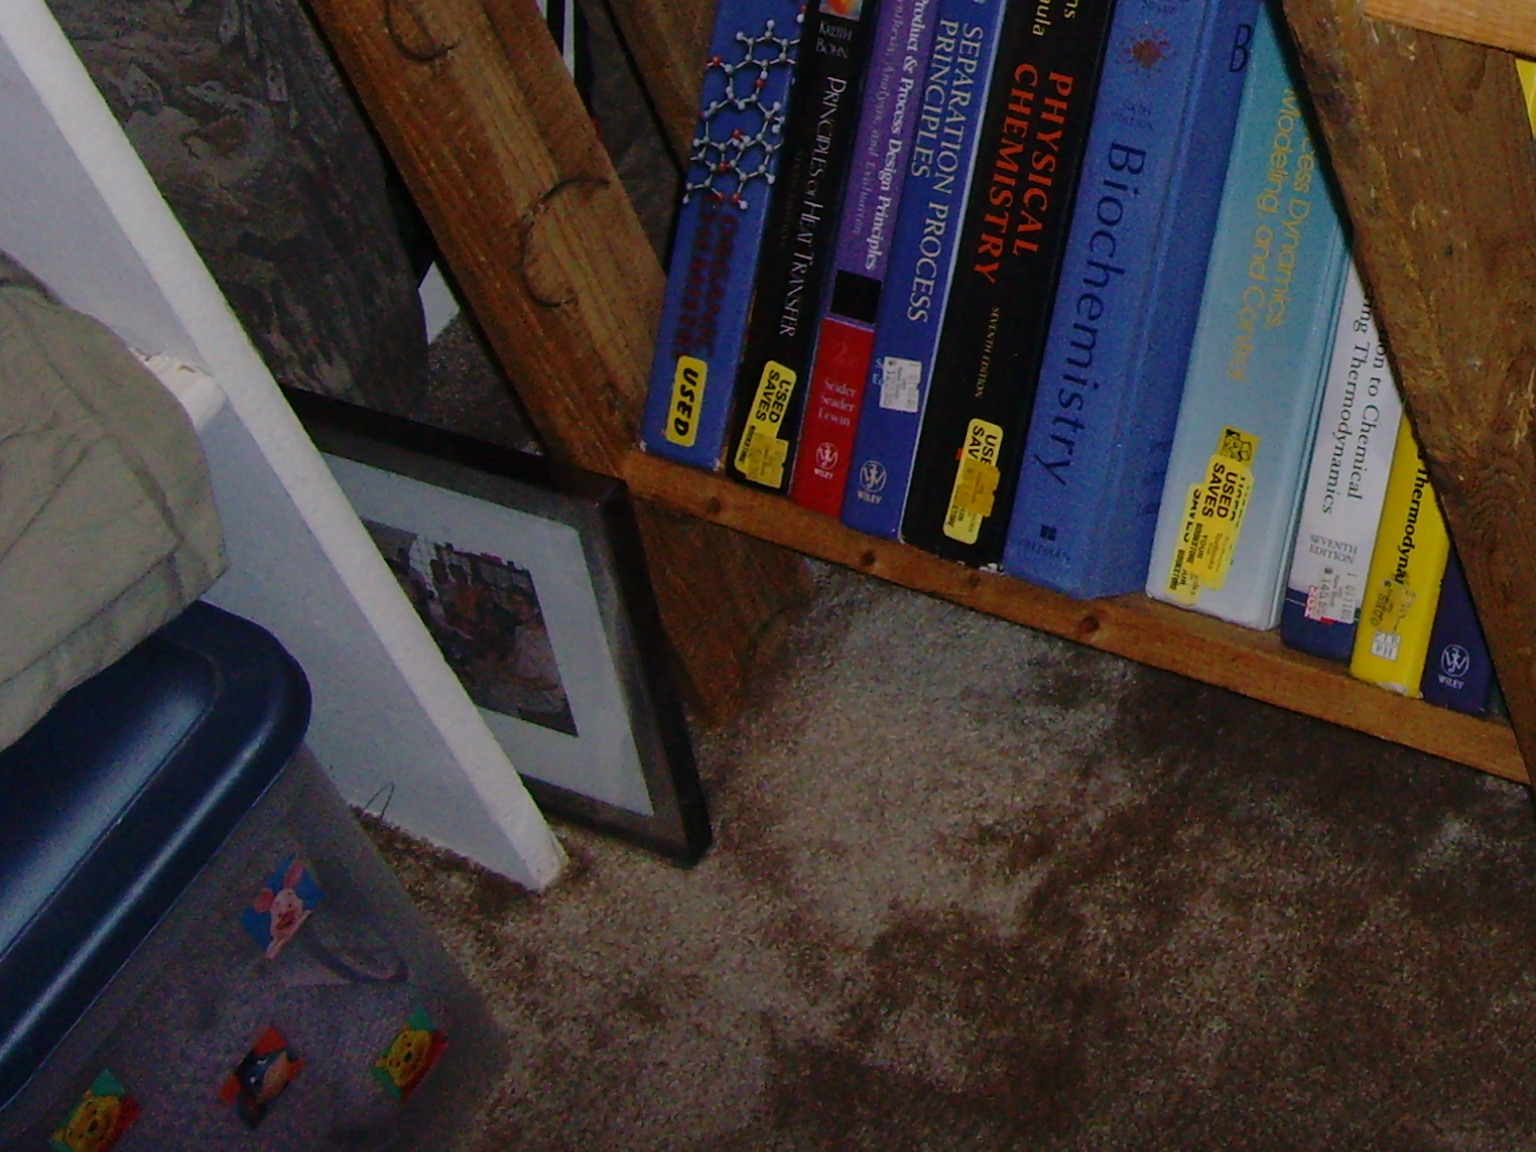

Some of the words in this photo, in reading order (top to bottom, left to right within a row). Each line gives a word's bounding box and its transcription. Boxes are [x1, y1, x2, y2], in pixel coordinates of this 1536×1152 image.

[902, 55, 918, 73] &
[891, 76, 915, 134] Process
[911, 18, 959, 179] PRINCIPLES
[932, 24, 984, 195] SEPARATION
[878, 139, 902, 192] Design
[973, 62, 1040, 284] CHEMISTRY
[1011, 70, 1074, 256] PHYSICAL
[865, 193, 893, 271] Principles
[906, 202, 950, 323] PROCESS
[1033, 143, 1148, 487] Biochemistry
[674, 367, 699, 437] USED
[755, 369, 780, 422] SAVES
[769, 379, 792, 424] USED
[1367, 379, 1382, 397] to
[1320, 342, 1370, 515] Thermodynamics
[1346, 403, 1381, 501] Chemical
[857, 490, 883, 504] WILEY
[1201, 462, 1226, 518] SAVES
[1216, 472, 1238, 519] USED
[1308, 546, 1355, 565] EDITION
[1309, 534, 1358, 555] SEVENTH
[1438, 674, 1465, 690] WILEY
